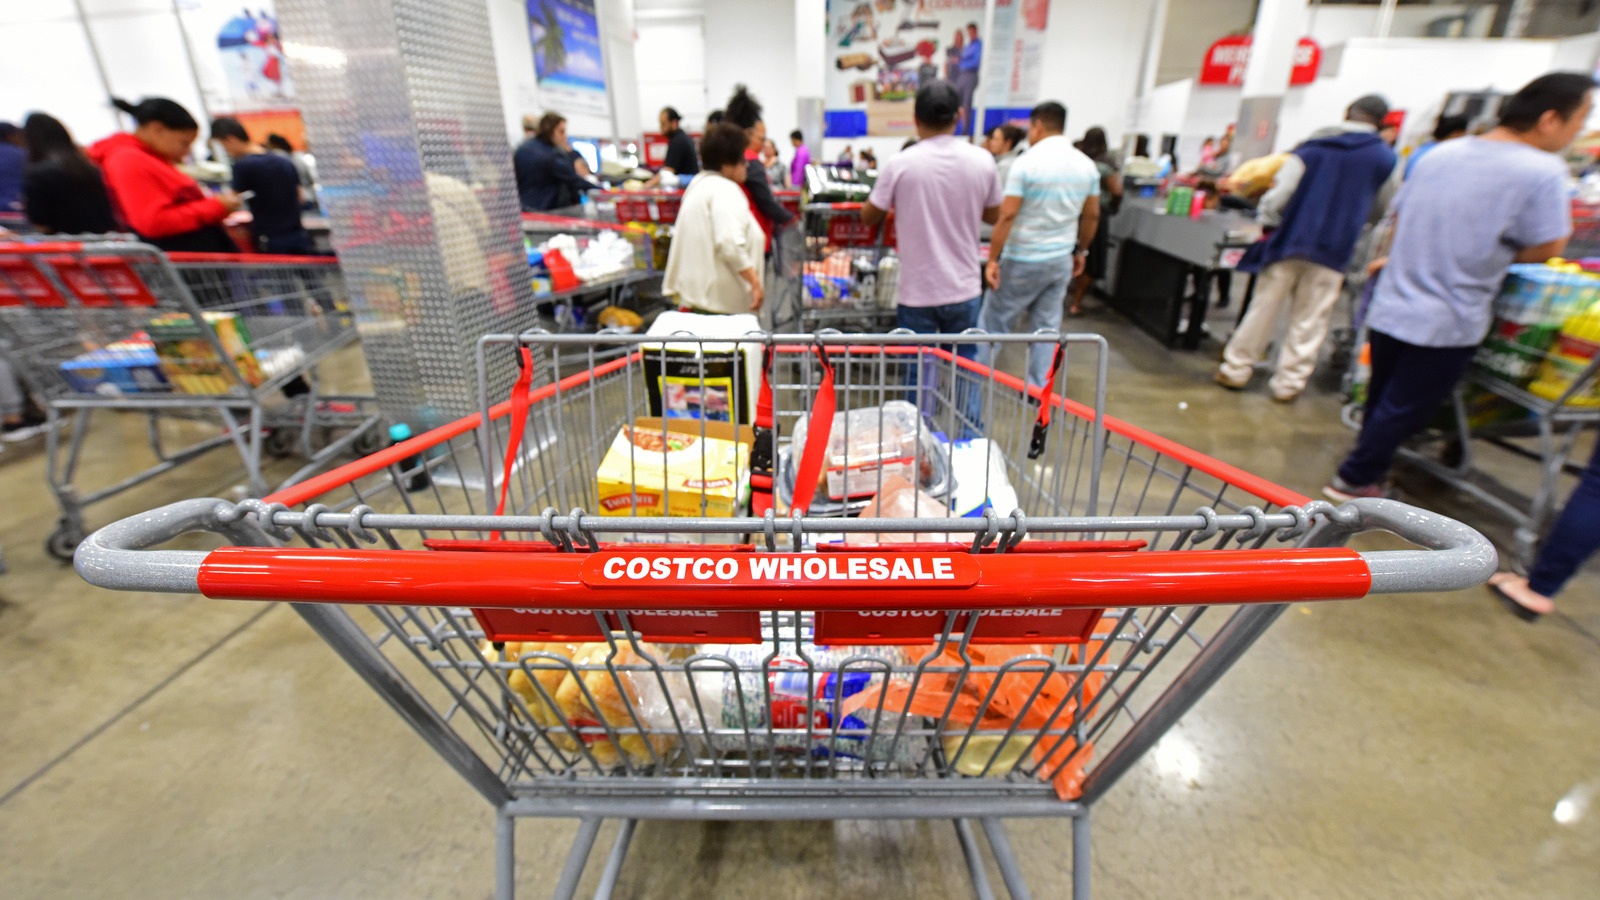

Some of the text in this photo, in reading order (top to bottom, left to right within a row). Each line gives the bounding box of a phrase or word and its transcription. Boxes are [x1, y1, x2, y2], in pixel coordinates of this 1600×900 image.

[603, 557, 955, 580] COSTCO WHOLESALE
[597, 609, 719, 617] OLESALE
[944, 608, 1063, 616] HOLESALE
